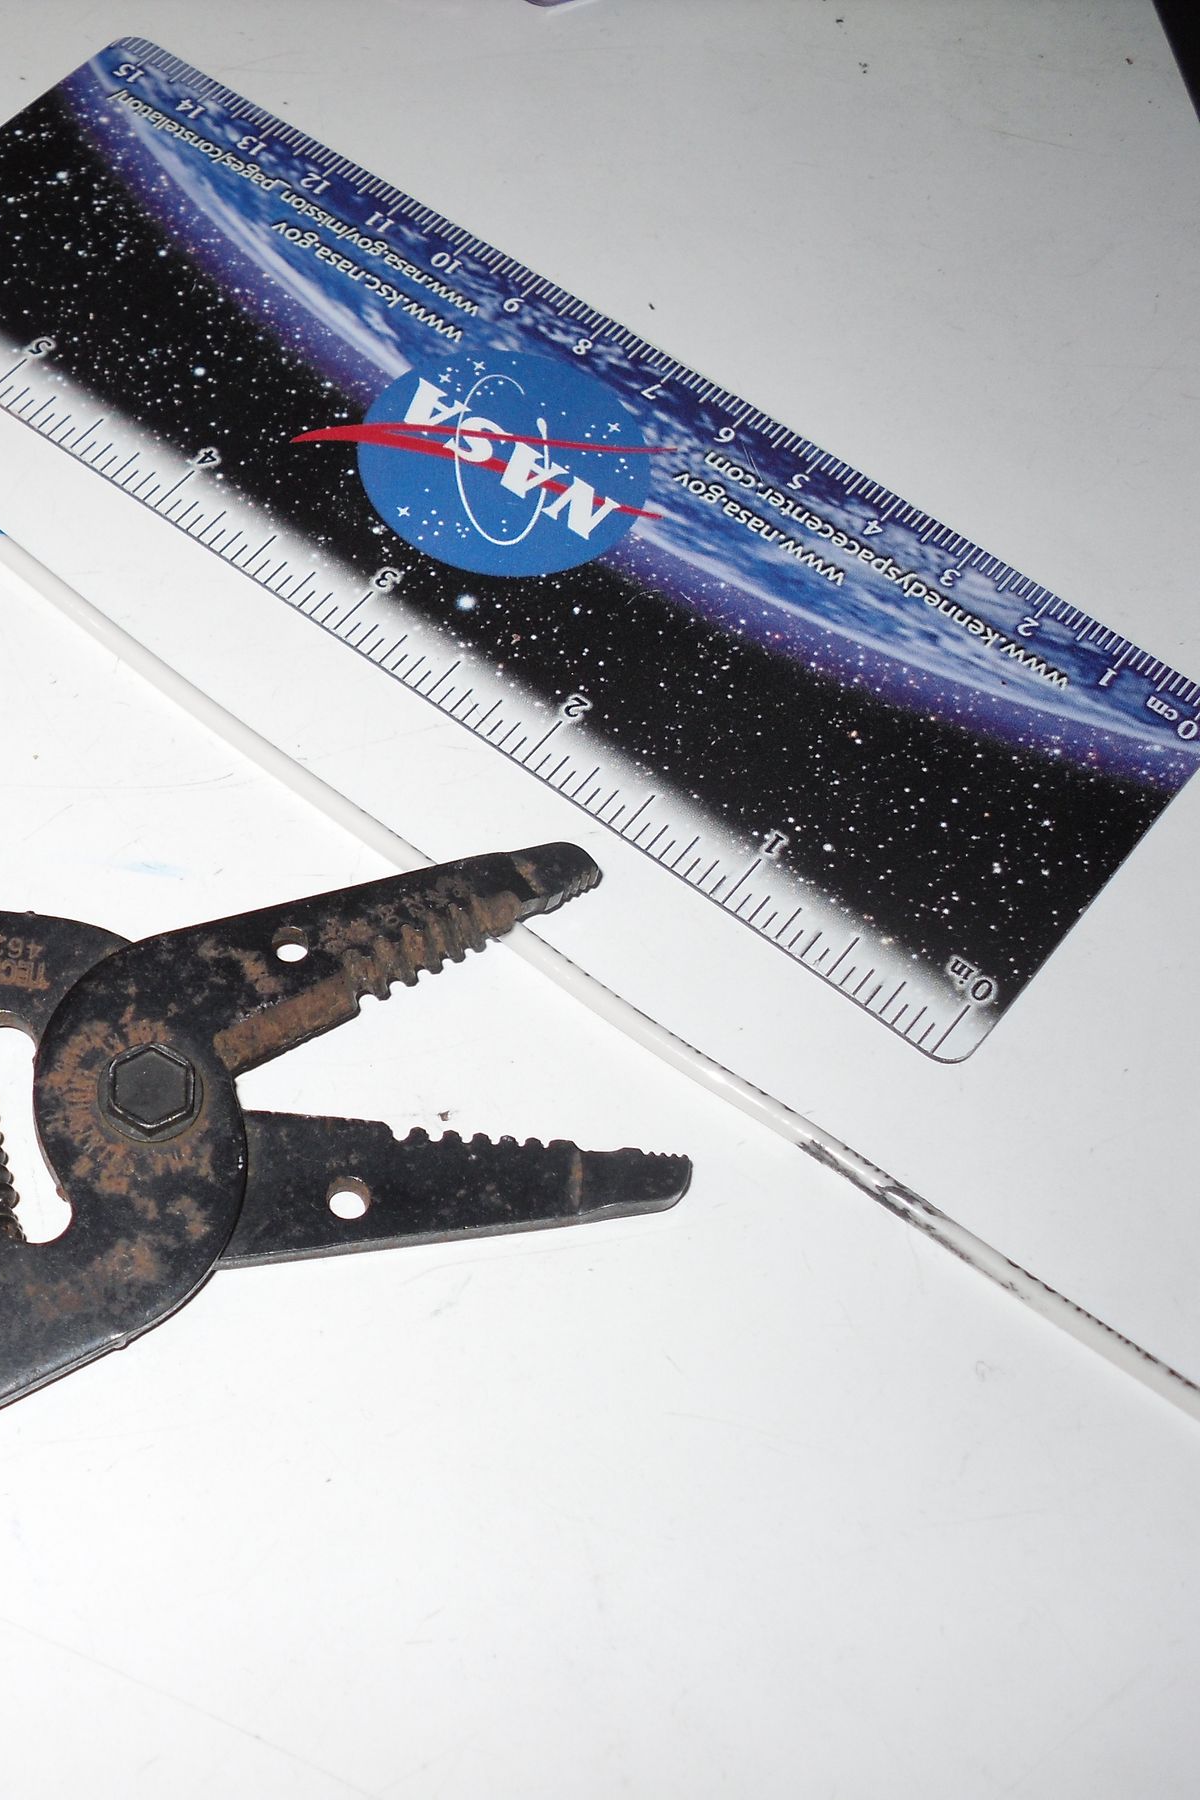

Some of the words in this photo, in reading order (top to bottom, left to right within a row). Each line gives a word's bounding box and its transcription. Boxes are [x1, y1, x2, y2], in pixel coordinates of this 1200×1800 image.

[113, 62, 144, 84] 15
[175, 99, 205, 120] 14
[236, 135, 267, 156] 13
[300, 172, 331, 195] 12
[108, 89, 480, 318] www.nasa.gov/mission_pages/constellation/
[365, 210, 397, 233] 11
[430, 251, 463, 275] 10
[271, 220, 463, 344] www.ksc.nasa.gov
[503, 297, 525, 314] 9
[28, 337, 56, 357] 5
[572, 338, 593, 355] 8
[640, 383, 664, 400] 7
[713, 426, 735, 443] 6
[196, 448, 219, 468] 4
[404, 377, 621, 540] NASA
[787, 473, 811, 491] 5
[673, 472, 846, 586] www.nasa.gov
[862, 519, 884, 537] 4
[374, 568, 399, 590] 3
[704, 451, 1069, 690] www.kennedyspacecenter.com
[940, 569, 961, 587] 3
[1017, 616, 1040, 636] 2
[1098, 668, 1118, 686] 1
[563, 696, 590, 718] 2
[1146, 695, 1178, 721] cm
[1177, 719, 1199, 740] 0
[762, 833, 786, 855] 1
[951, 957, 974, 986] in
[969, 976, 994, 1001] 0
